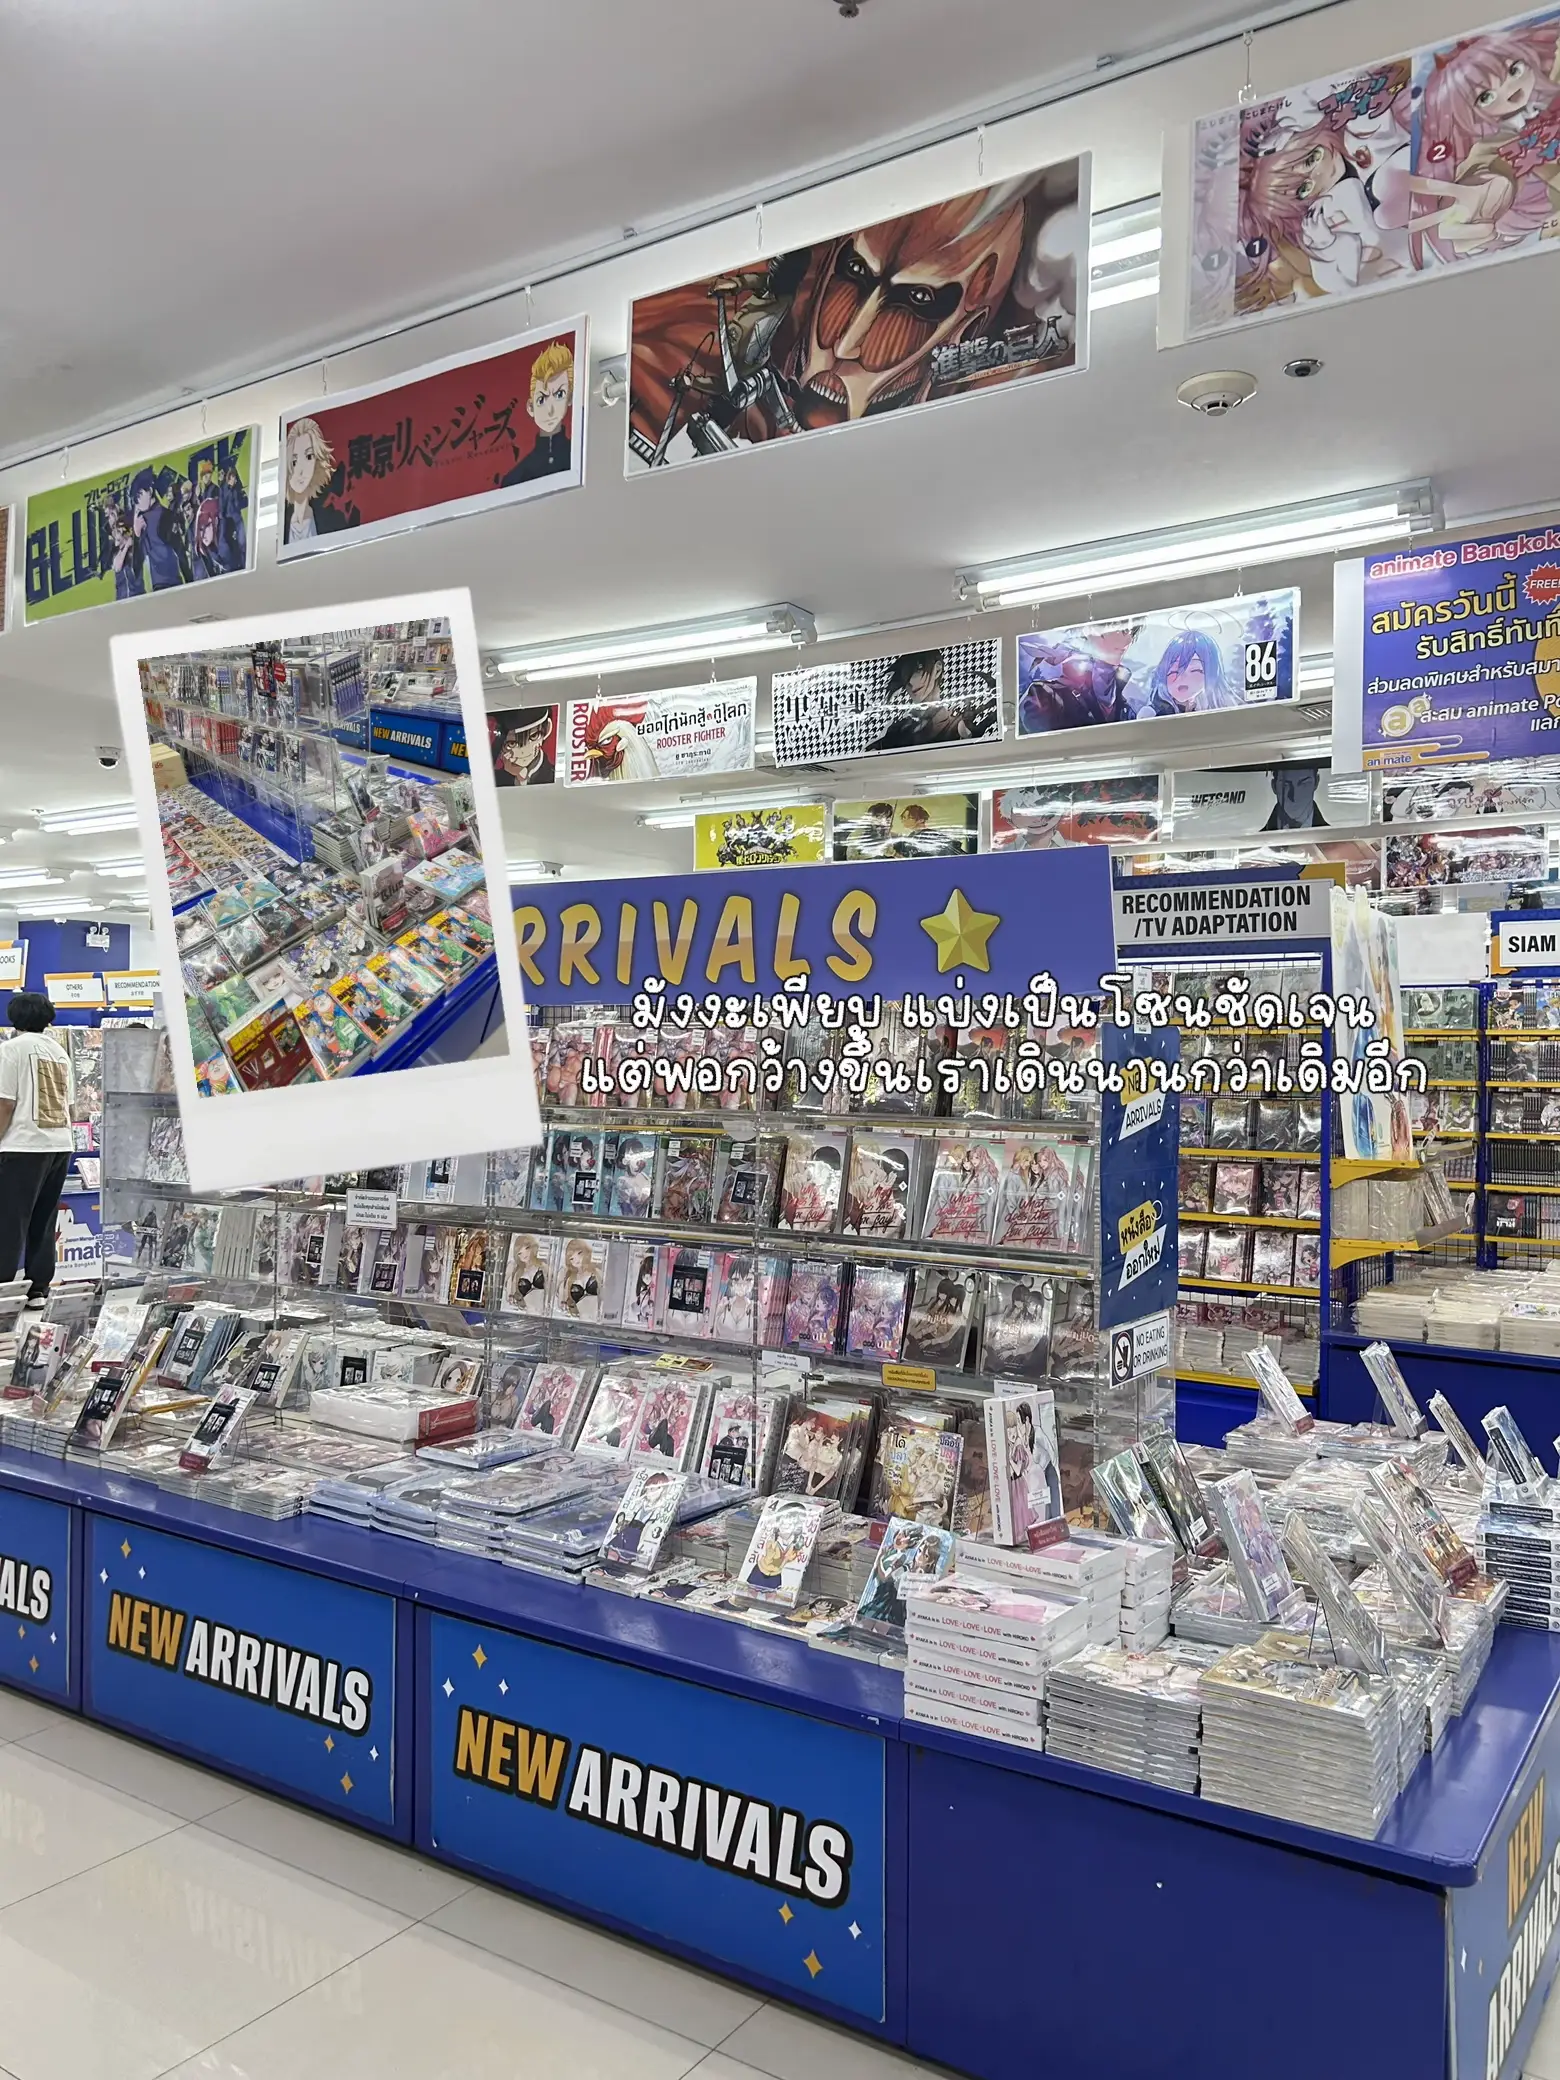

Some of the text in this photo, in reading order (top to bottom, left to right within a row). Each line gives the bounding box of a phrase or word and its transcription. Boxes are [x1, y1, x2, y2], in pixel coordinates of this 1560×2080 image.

[1433, 146, 1447, 161] 2
[1250, 240, 1262, 256] 1
[348, 394, 519, 479] 東京リベンジャーズ
[1371, 530, 1560, 578] animate Bangkok
[1372, 573, 1518, 635] สมัครวันนี้
[1245, 641, 1277, 683] 86
[1419, 708, 1464, 725] สะสม
[1467, 698, 1539, 720] animate
[571, 703, 589, 782] ROOSTER
[657, 726, 726, 750] ROOSTER FIGHTER
[1122, 885, 1311, 914] RECOMMENDATION
[1171, 911, 1297, 936] ADAPTATION
[1508, 935, 1556, 953] SIAM
[115, 981, 160, 989] RECOMMENDATION
[1126, 1099, 1162, 1129] ARRIVALS
[1126, 1240, 1160, 1280] ออกใหม่
[1136, 1326, 1165, 1348] NO EATING
[1134, 1345, 1168, 1368] OR DRINKING
[108, 1593, 369, 1731] NEW ARRIVALS
[456, 1709, 847, 1899] NEW ARRIVALS
[1508, 1775, 1545, 1929] NEW
